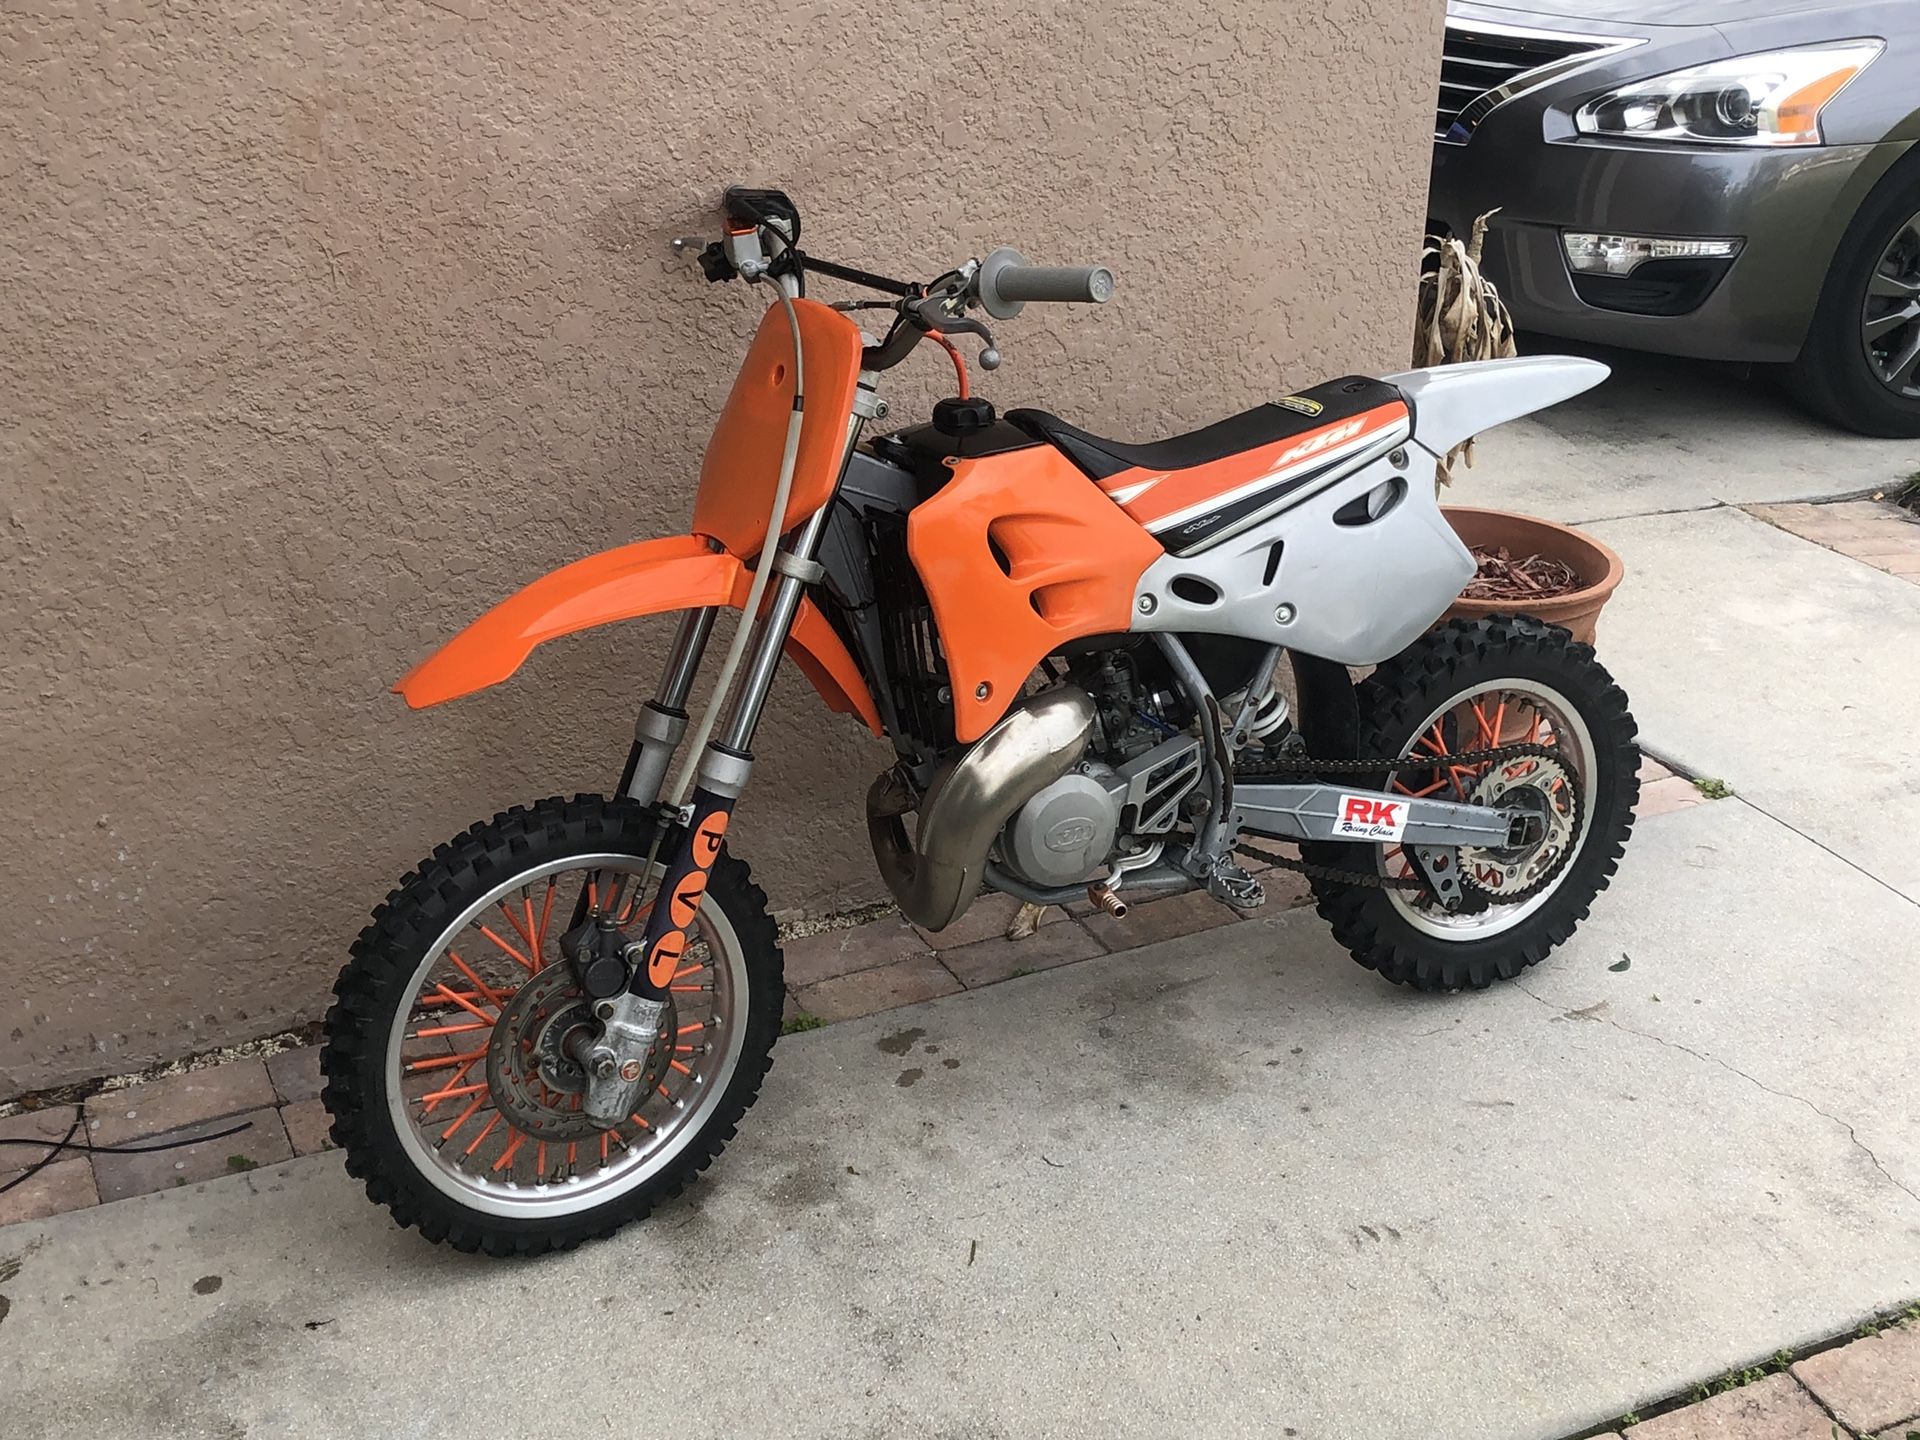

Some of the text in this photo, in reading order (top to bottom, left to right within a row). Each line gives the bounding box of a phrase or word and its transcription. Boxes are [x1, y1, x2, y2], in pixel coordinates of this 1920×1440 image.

[1343, 798, 1399, 827] RK
[1340, 822, 1394, 837] Racing Chain
